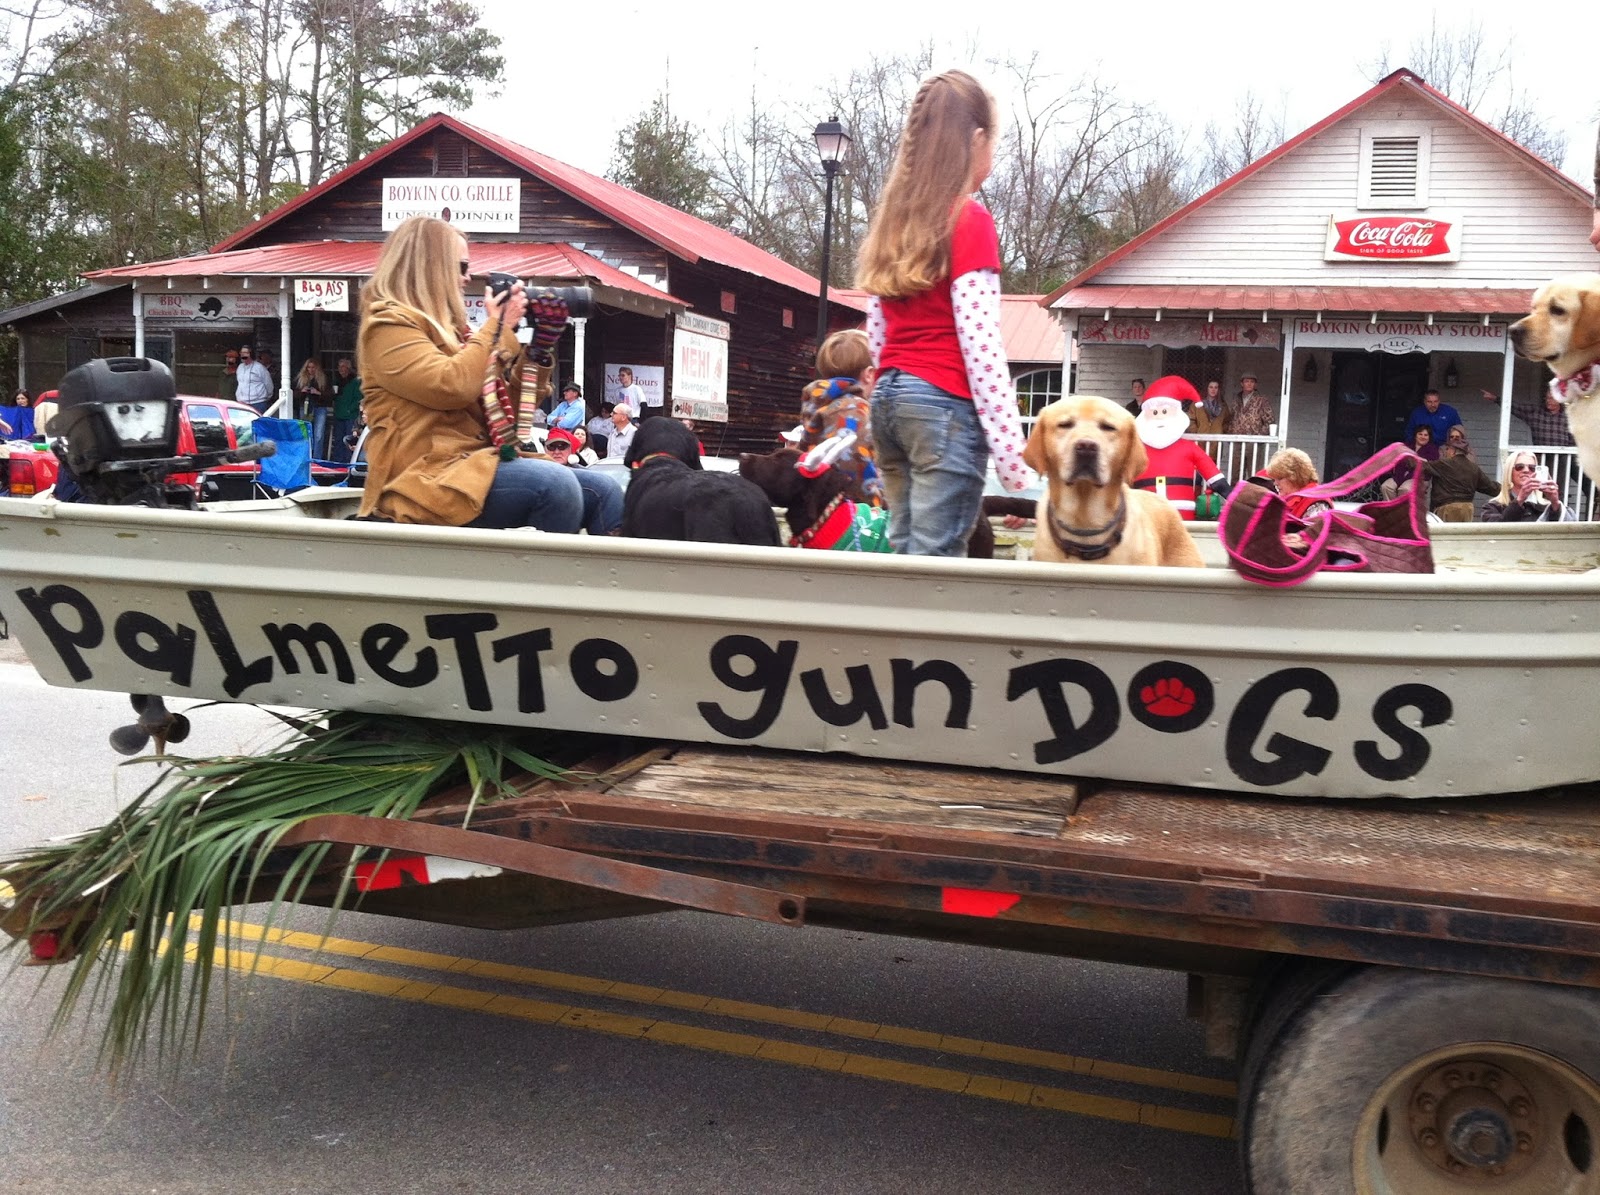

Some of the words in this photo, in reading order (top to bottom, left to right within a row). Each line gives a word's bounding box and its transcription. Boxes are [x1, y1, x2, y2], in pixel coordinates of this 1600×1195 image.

[389, 185, 437, 201] BOYKIN
[441, 185, 462, 201] CO.
[466, 185, 514, 201] GRILLE
[455, 212, 514, 220] DINNER
[1349, 221, 1436, 247] Coca-Cola
[160, 295, 182, 308] BBQ
[1113, 324, 1150, 340] Grits
[1200, 327, 1238, 342] Meal
[1300, 321, 1360, 334] BOYKIN
[1365, 322, 1445, 336] COMPANY
[1449, 324, 1502, 338] STORE
[682, 346, 710, 379] NEHI
[1006, 657, 1453, 787] DOGS
